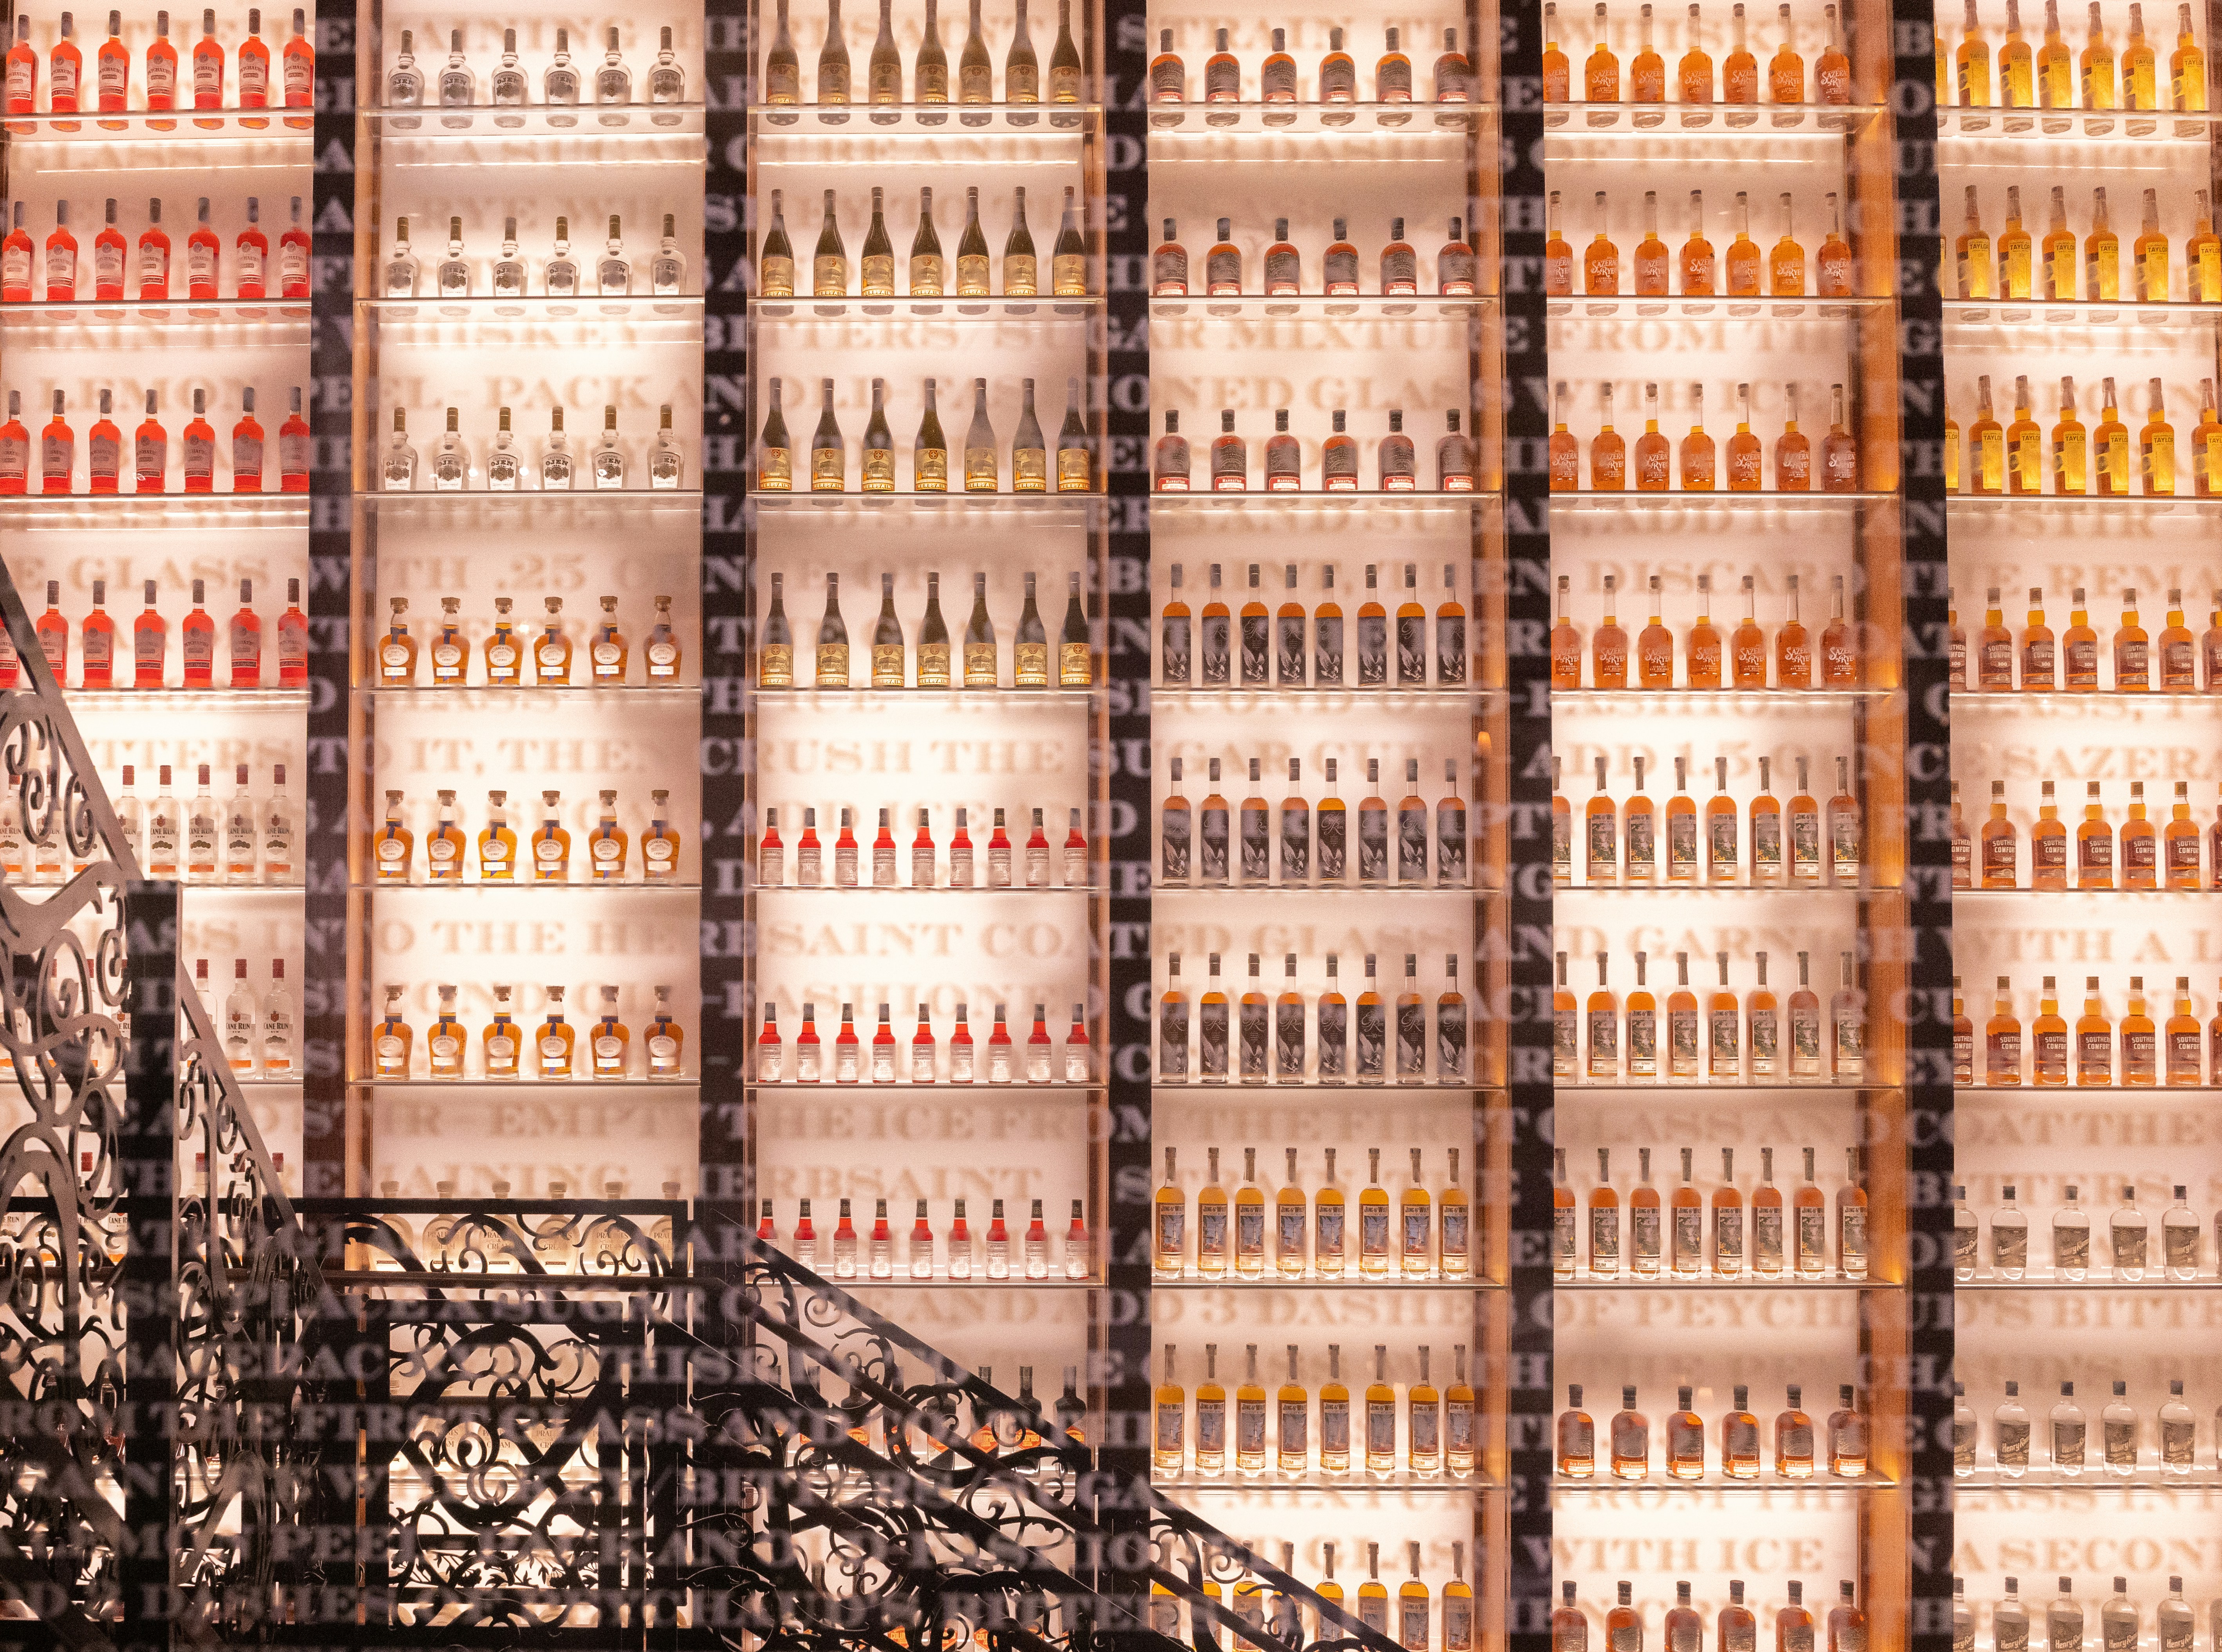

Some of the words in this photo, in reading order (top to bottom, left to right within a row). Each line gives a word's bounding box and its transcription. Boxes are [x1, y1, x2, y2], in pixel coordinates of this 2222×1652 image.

[487, 376, 650, 410] PACK
[69, 556, 270, 591] GLASS
[495, 553, 588, 591] .25
[929, 739, 1065, 774] THE
[432, 920, 566, 955] THE
[2133, 929, 2171, 962] A
[871, 1103, 976, 1141] ICE
[1718, 1537, 1824, 1573] ICE
